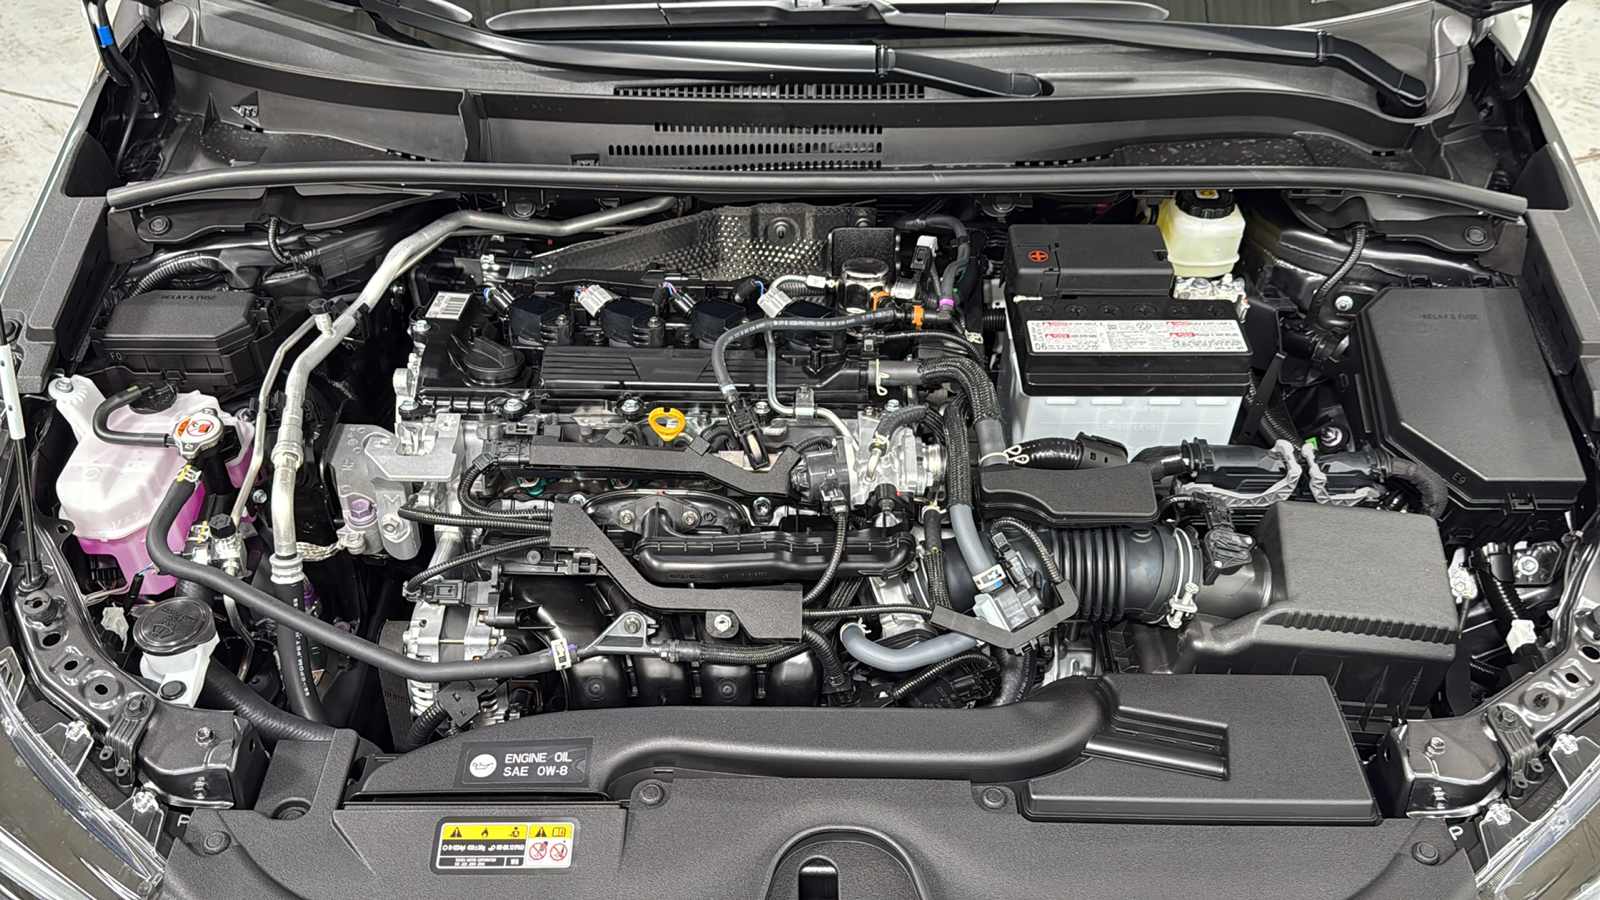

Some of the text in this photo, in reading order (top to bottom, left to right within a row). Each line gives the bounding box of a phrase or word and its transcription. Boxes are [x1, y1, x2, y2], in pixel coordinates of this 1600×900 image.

[504, 751, 573, 764] ENGINE OIL
[502, 766, 529, 777] SAE
